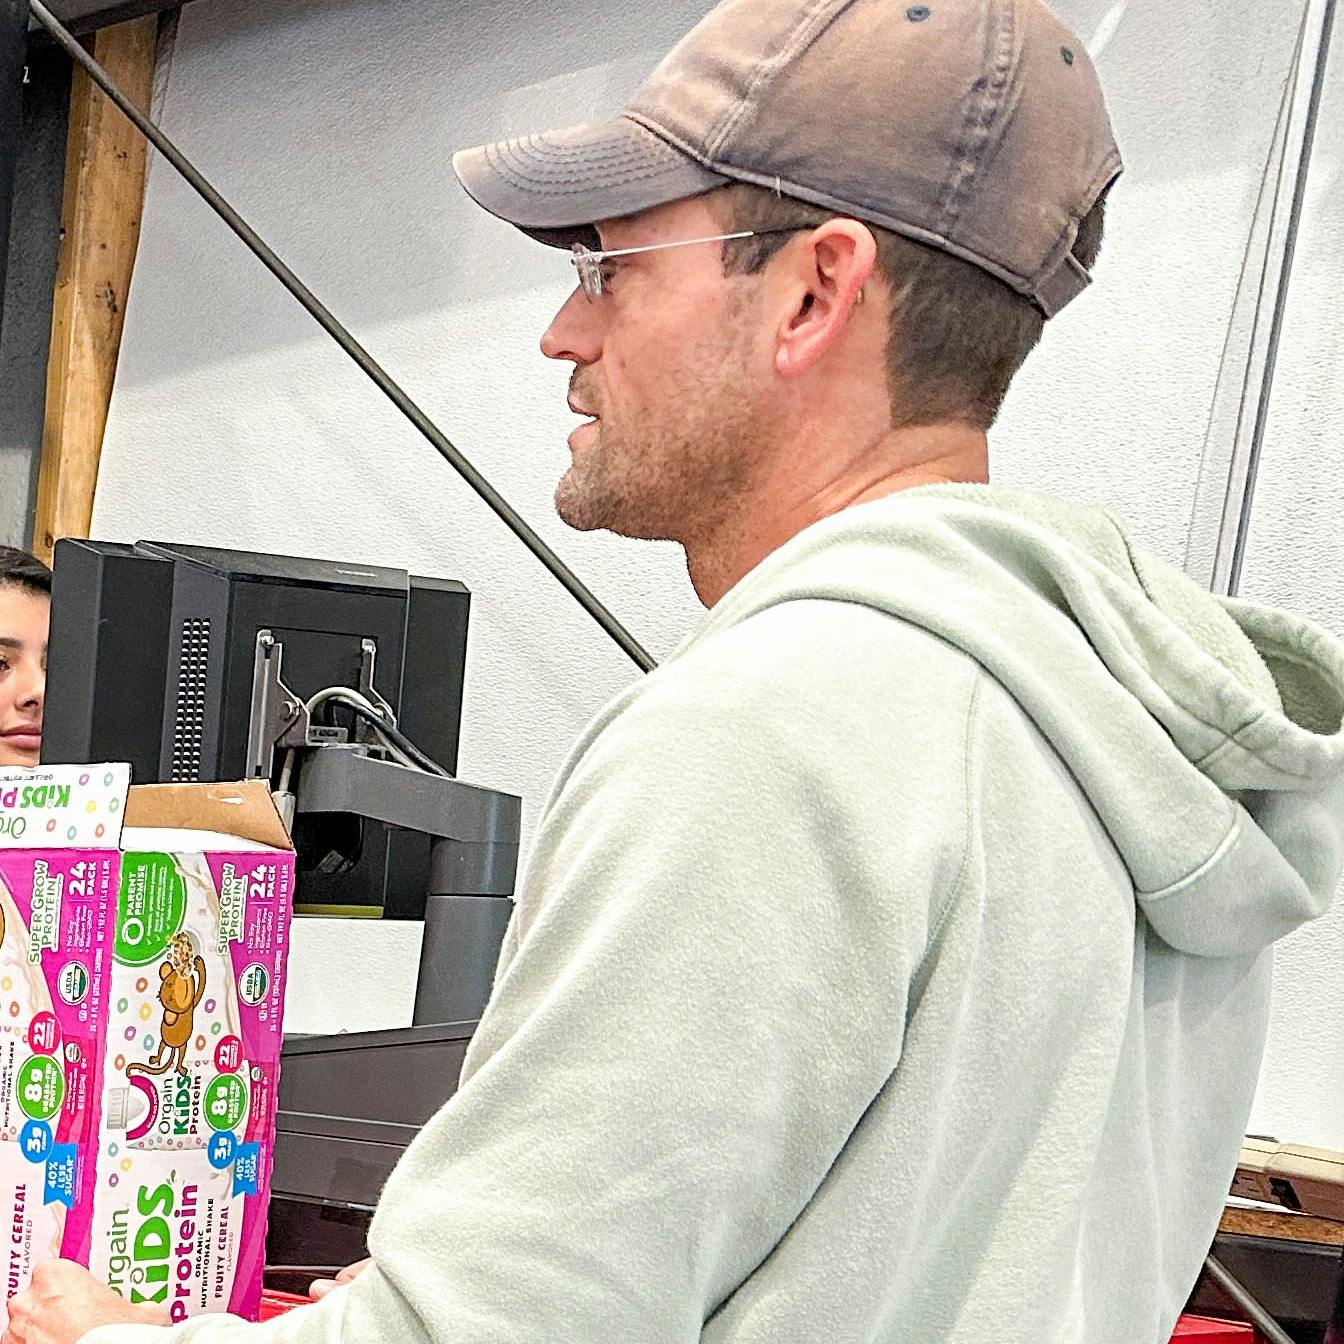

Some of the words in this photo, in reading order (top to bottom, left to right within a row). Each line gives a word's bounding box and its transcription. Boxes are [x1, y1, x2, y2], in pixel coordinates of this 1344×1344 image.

[33, 862, 47, 911] GROW
[68, 861, 87, 896] 24
[86, 861, 97, 896] PACK
[127, 872, 137, 915] PARENT
[135, 865, 145, 915] PROMISE
[222, 865, 234, 907] GROW
[250, 864, 267, 899] 24
[267, 865, 277, 898] PACK
[41, 880, 56, 946] PROTEIN
[218, 908, 230, 953] SUPER
[229, 880, 242, 938] PROTEIN
[29, 913, 42, 963] SUPER
[33, 1023, 45, 1047] 22
[219, 1045, 230, 1066] 22
[24, 1069, 43, 1102] 8g
[158, 1077, 174, 1134] Orgain
[190, 1075, 201, 1134] Protein
[211, 1086, 228, 1116] 8g
[26, 1126, 43, 1154] 3g
[214, 1137, 228, 1160] 3g
[48, 1161, 58, 1189] 40%
[12, 1184, 26, 1244] CEREAL
[218, 1206, 229, 1250] CEREAL
[22, 1219, 33, 1274] FLAVORED
[106, 1207, 131, 1298] rgain
[170, 1185, 198, 1323] Protein
[195, 1230, 204, 1278] ORGANIC
[201, 1236, 211, 1307] NUTRITIONAL
[206, 1198, 214, 1233] SHAKE
[6, 1250, 21, 1299] RUITY
[215, 1255, 226, 1299] FRUITY
